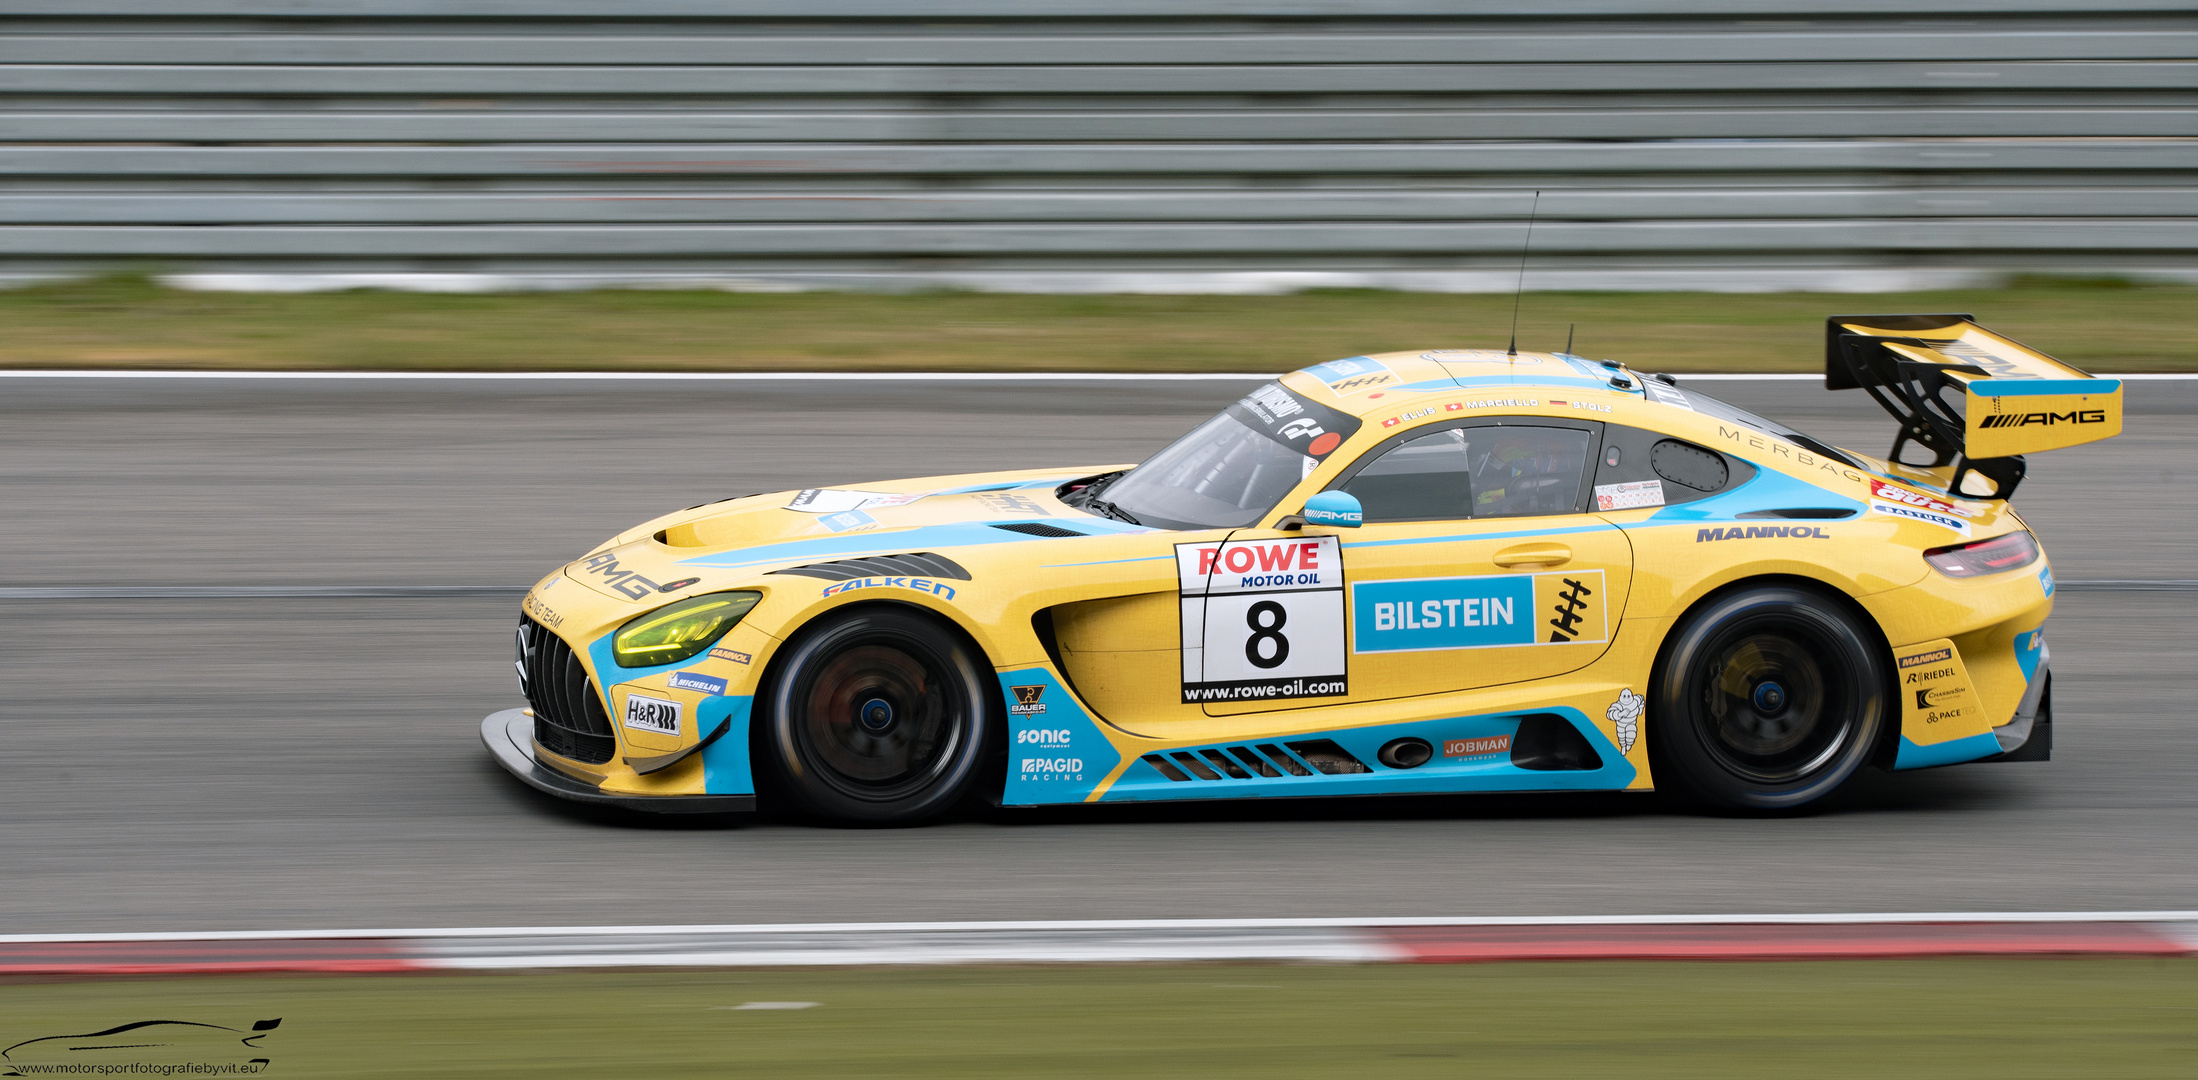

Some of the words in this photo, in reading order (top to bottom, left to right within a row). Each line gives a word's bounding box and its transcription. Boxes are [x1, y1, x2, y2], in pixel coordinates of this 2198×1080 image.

[1466, 399, 1539, 409] MARCIELLO
[1573, 401, 1613, 412] STOLZ
[1401, 407, 1436, 421] ELLIS
[2018, 410, 2105, 426] AMG
[1719, 426, 1862, 483] MERBAG
[1316, 510, 1362, 521] AMG
[1885, 507, 1953, 526] BASTUCK
[1696, 526, 1830, 543] MANNOL
[1195, 543, 1319, 575] ROWE
[583, 553, 660, 601] AMG
[1241, 575, 1294, 587] MOTOR
[1298, 573, 1321, 585] OIL
[820, 577, 956, 601] FALKEN
[541, 607, 565, 629] TEAM
[1375, 597, 1514, 631] BILSTEIN
[1245, 600, 1290, 669] 8
[1902, 650, 1950, 667] MANNOL
[1923, 667, 1956, 681] RIEDEL
[677, 679, 722, 693] MICHELIN
[1184, 680, 1345, 700] www.rowe-oil.com
[628, 700, 656, 725] H&R
[1011, 703, 1046, 711] BAUER
[1446, 738, 1508, 754] JOBMAN
[1035, 758, 1083, 772] PAGID
